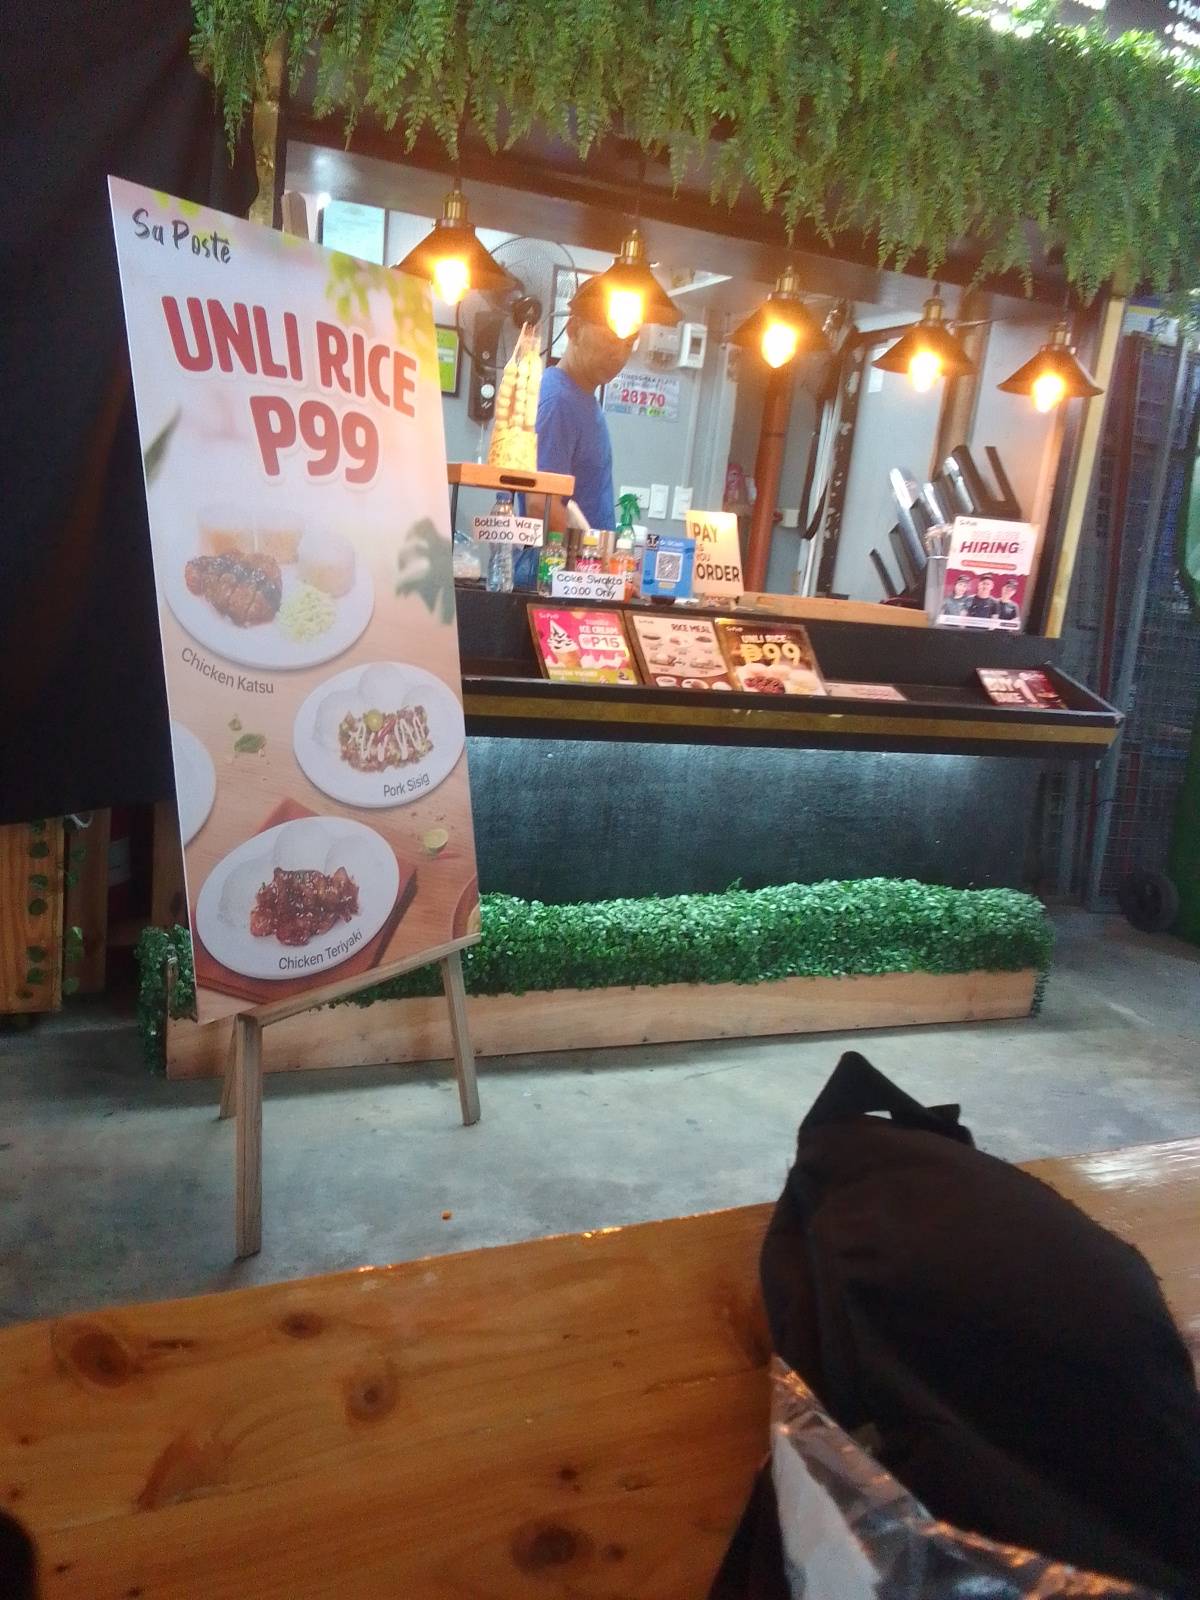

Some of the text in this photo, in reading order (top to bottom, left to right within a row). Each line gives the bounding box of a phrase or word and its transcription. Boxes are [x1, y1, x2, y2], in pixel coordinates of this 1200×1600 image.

[161, 296, 417, 418] UNLI RICE
[250, 396, 379, 484] P99
[474, 517, 510, 527] Bottled
[692, 523, 717, 543] PAY
[960, 541, 1020, 553] HIRING
[696, 563, 740, 582] ORDER
[181, 648, 274, 694] Chicken Katsu
[383, 773, 430, 798] Pork Sisig
[278, 930, 363, 970] Chicken Teriyaki
